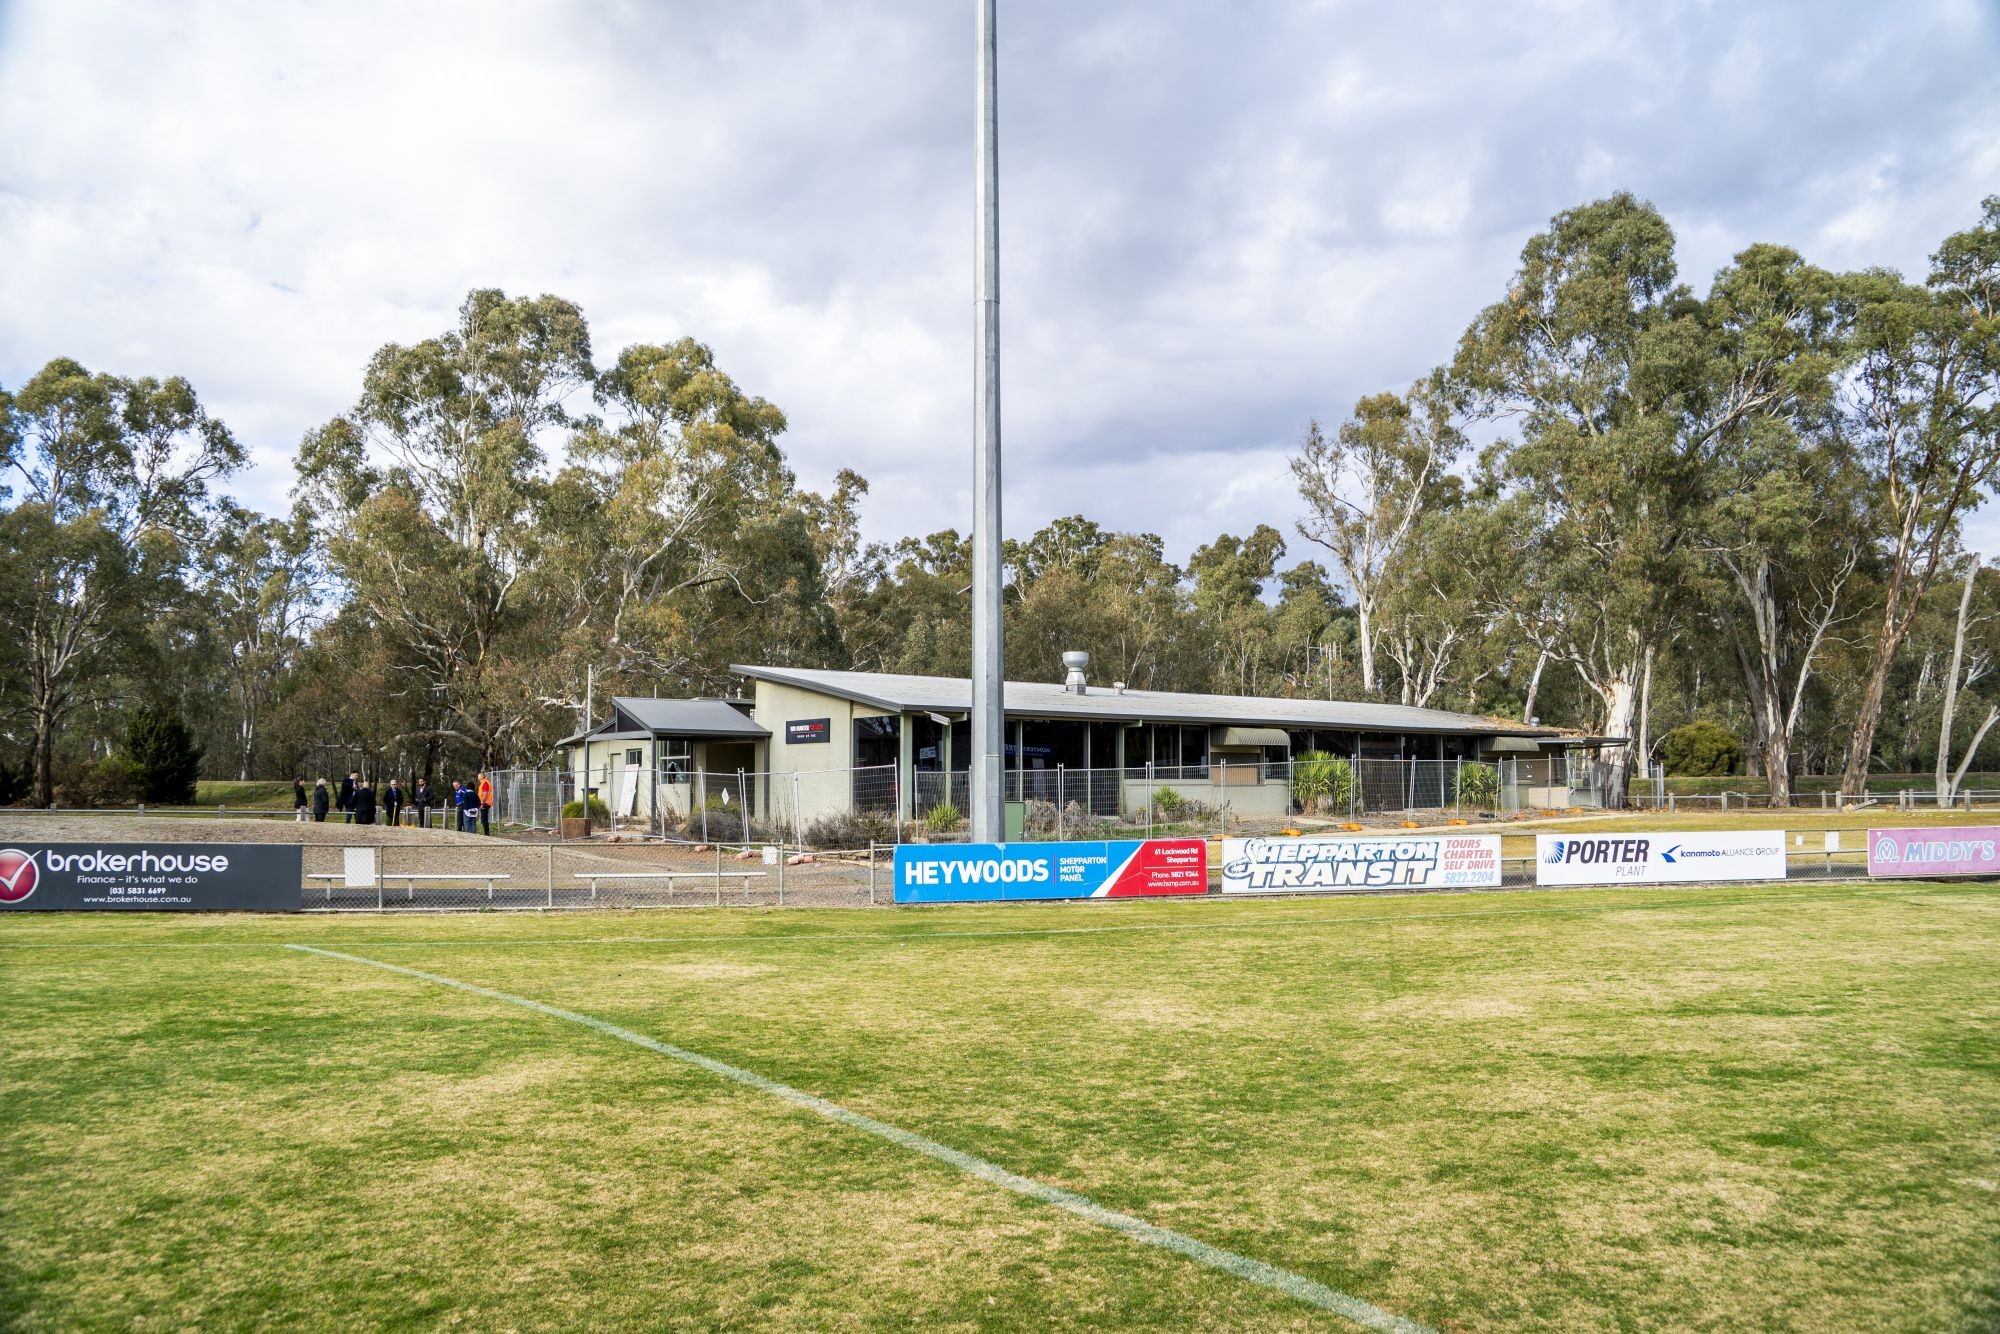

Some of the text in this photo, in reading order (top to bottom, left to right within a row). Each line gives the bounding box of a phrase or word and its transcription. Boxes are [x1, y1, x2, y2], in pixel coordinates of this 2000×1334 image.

[1446, 839, 1482, 849] TOURS
[1246, 838, 1439, 863] SHEPPARTON
[1443, 849, 1493, 860] CHARTER
[1565, 839, 1650, 864] PORTER
[1680, 847, 1780, 857] kanamoto ALLIANCE GROUP
[46, 850, 229, 872] brokerhouse
[1059, 856, 1107, 865] SHEPPARTON
[1166, 856, 1199, 864] Shepparton
[1443, 859, 1496, 871] SELF DRIVE
[905, 859, 1049, 885] HEYWOODS
[1060, 865, 1086, 873] MOTOR
[1248, 857, 1437, 889] TRANSIT
[1615, 866, 1647, 876] PLANT
[77, 875, 116, 884] Finance
[125, 875, 139, 884] it's
[141, 875, 166, 884] what
[184, 876, 198, 884] do
[1060, 873, 1085, 882] PANEL
[1443, 871, 1495, 884] 5822.2204
[109, 887, 167, 895] (03) 5831 6699
[83, 895, 192, 903] www.brokerhouse.com.au
